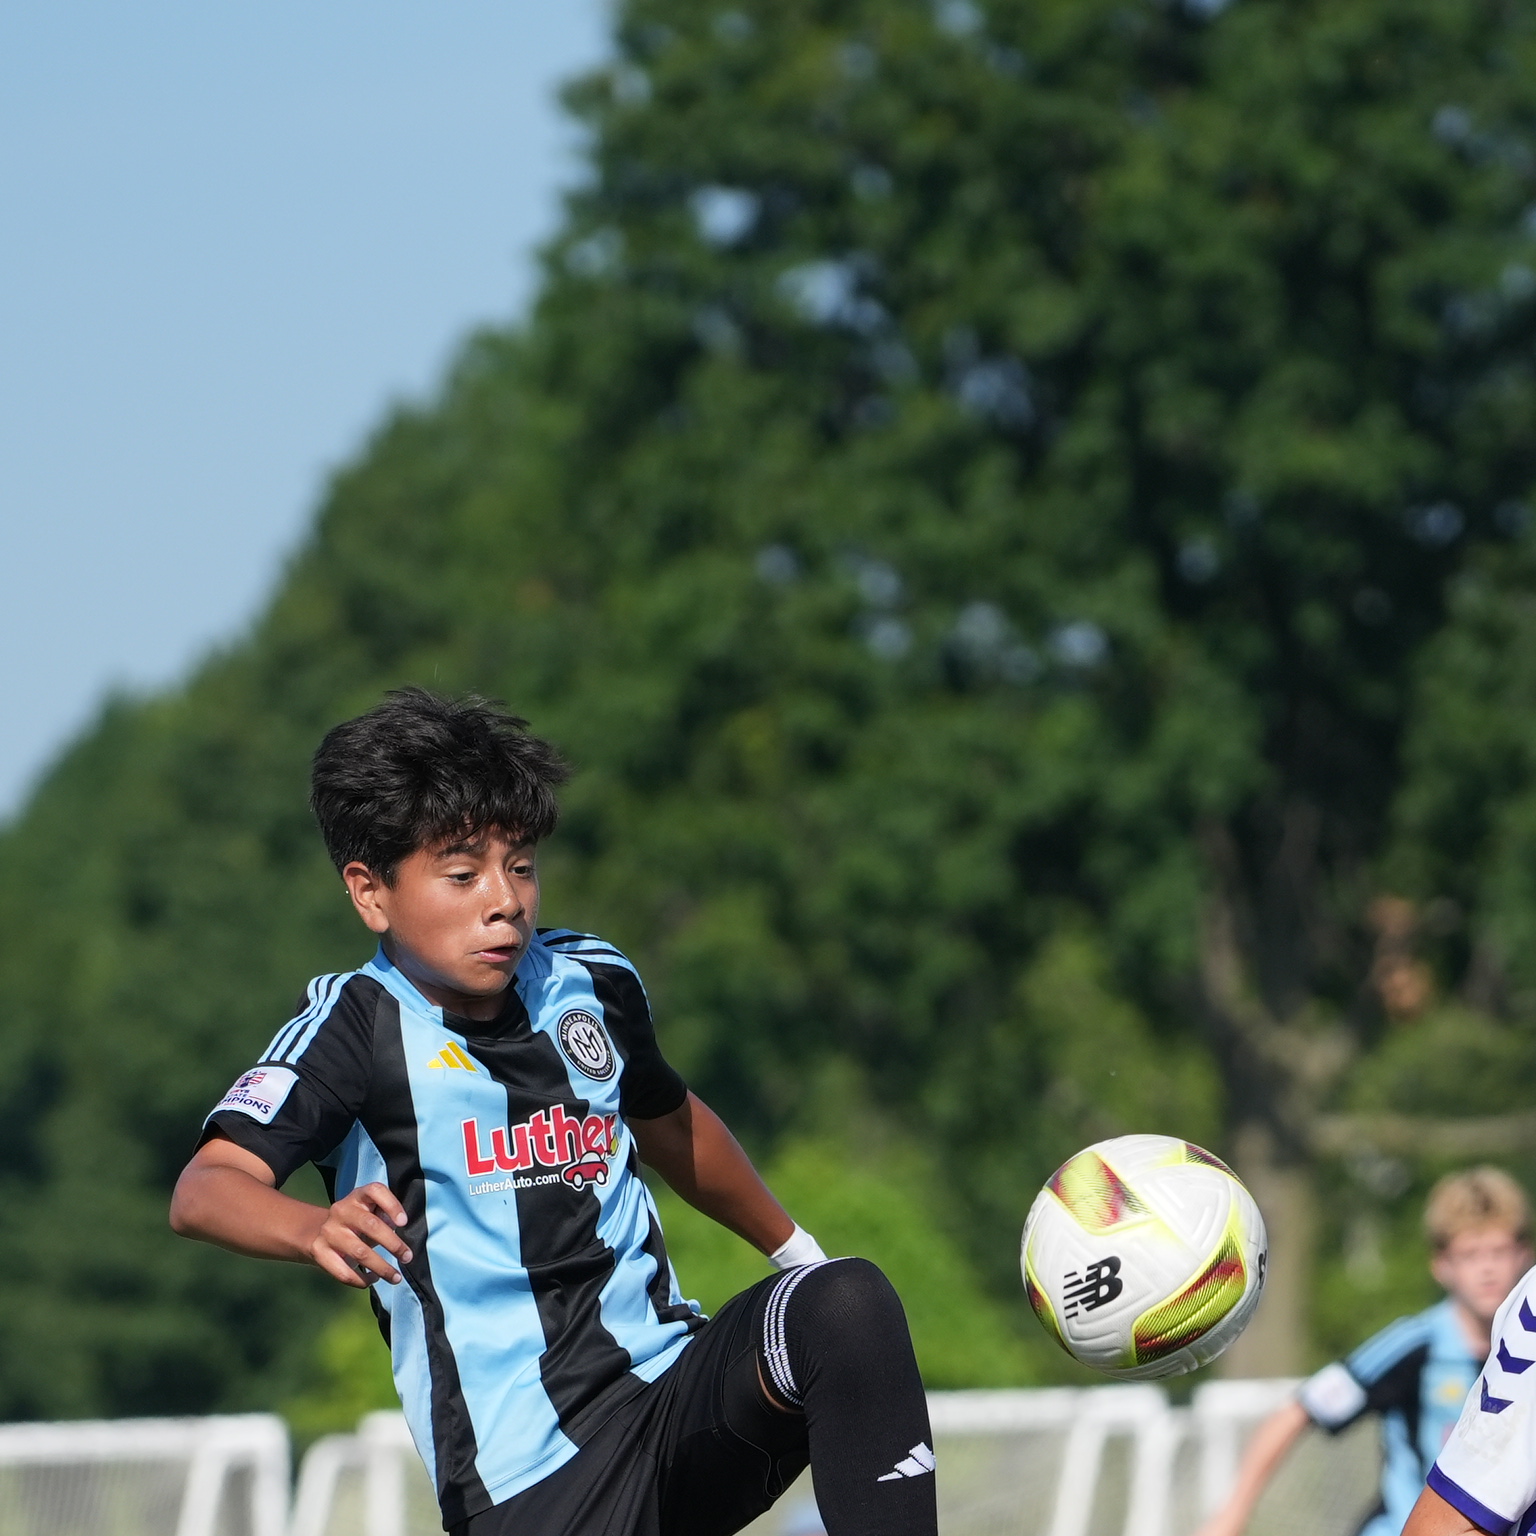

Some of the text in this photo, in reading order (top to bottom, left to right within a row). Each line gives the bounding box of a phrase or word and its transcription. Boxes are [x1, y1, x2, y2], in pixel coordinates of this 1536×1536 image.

[561, 1014, 598, 1041] MINNEAPOLIS
[462, 1104, 618, 1177] Luther
[469, 1173, 560, 1196] LutherAuto.com
